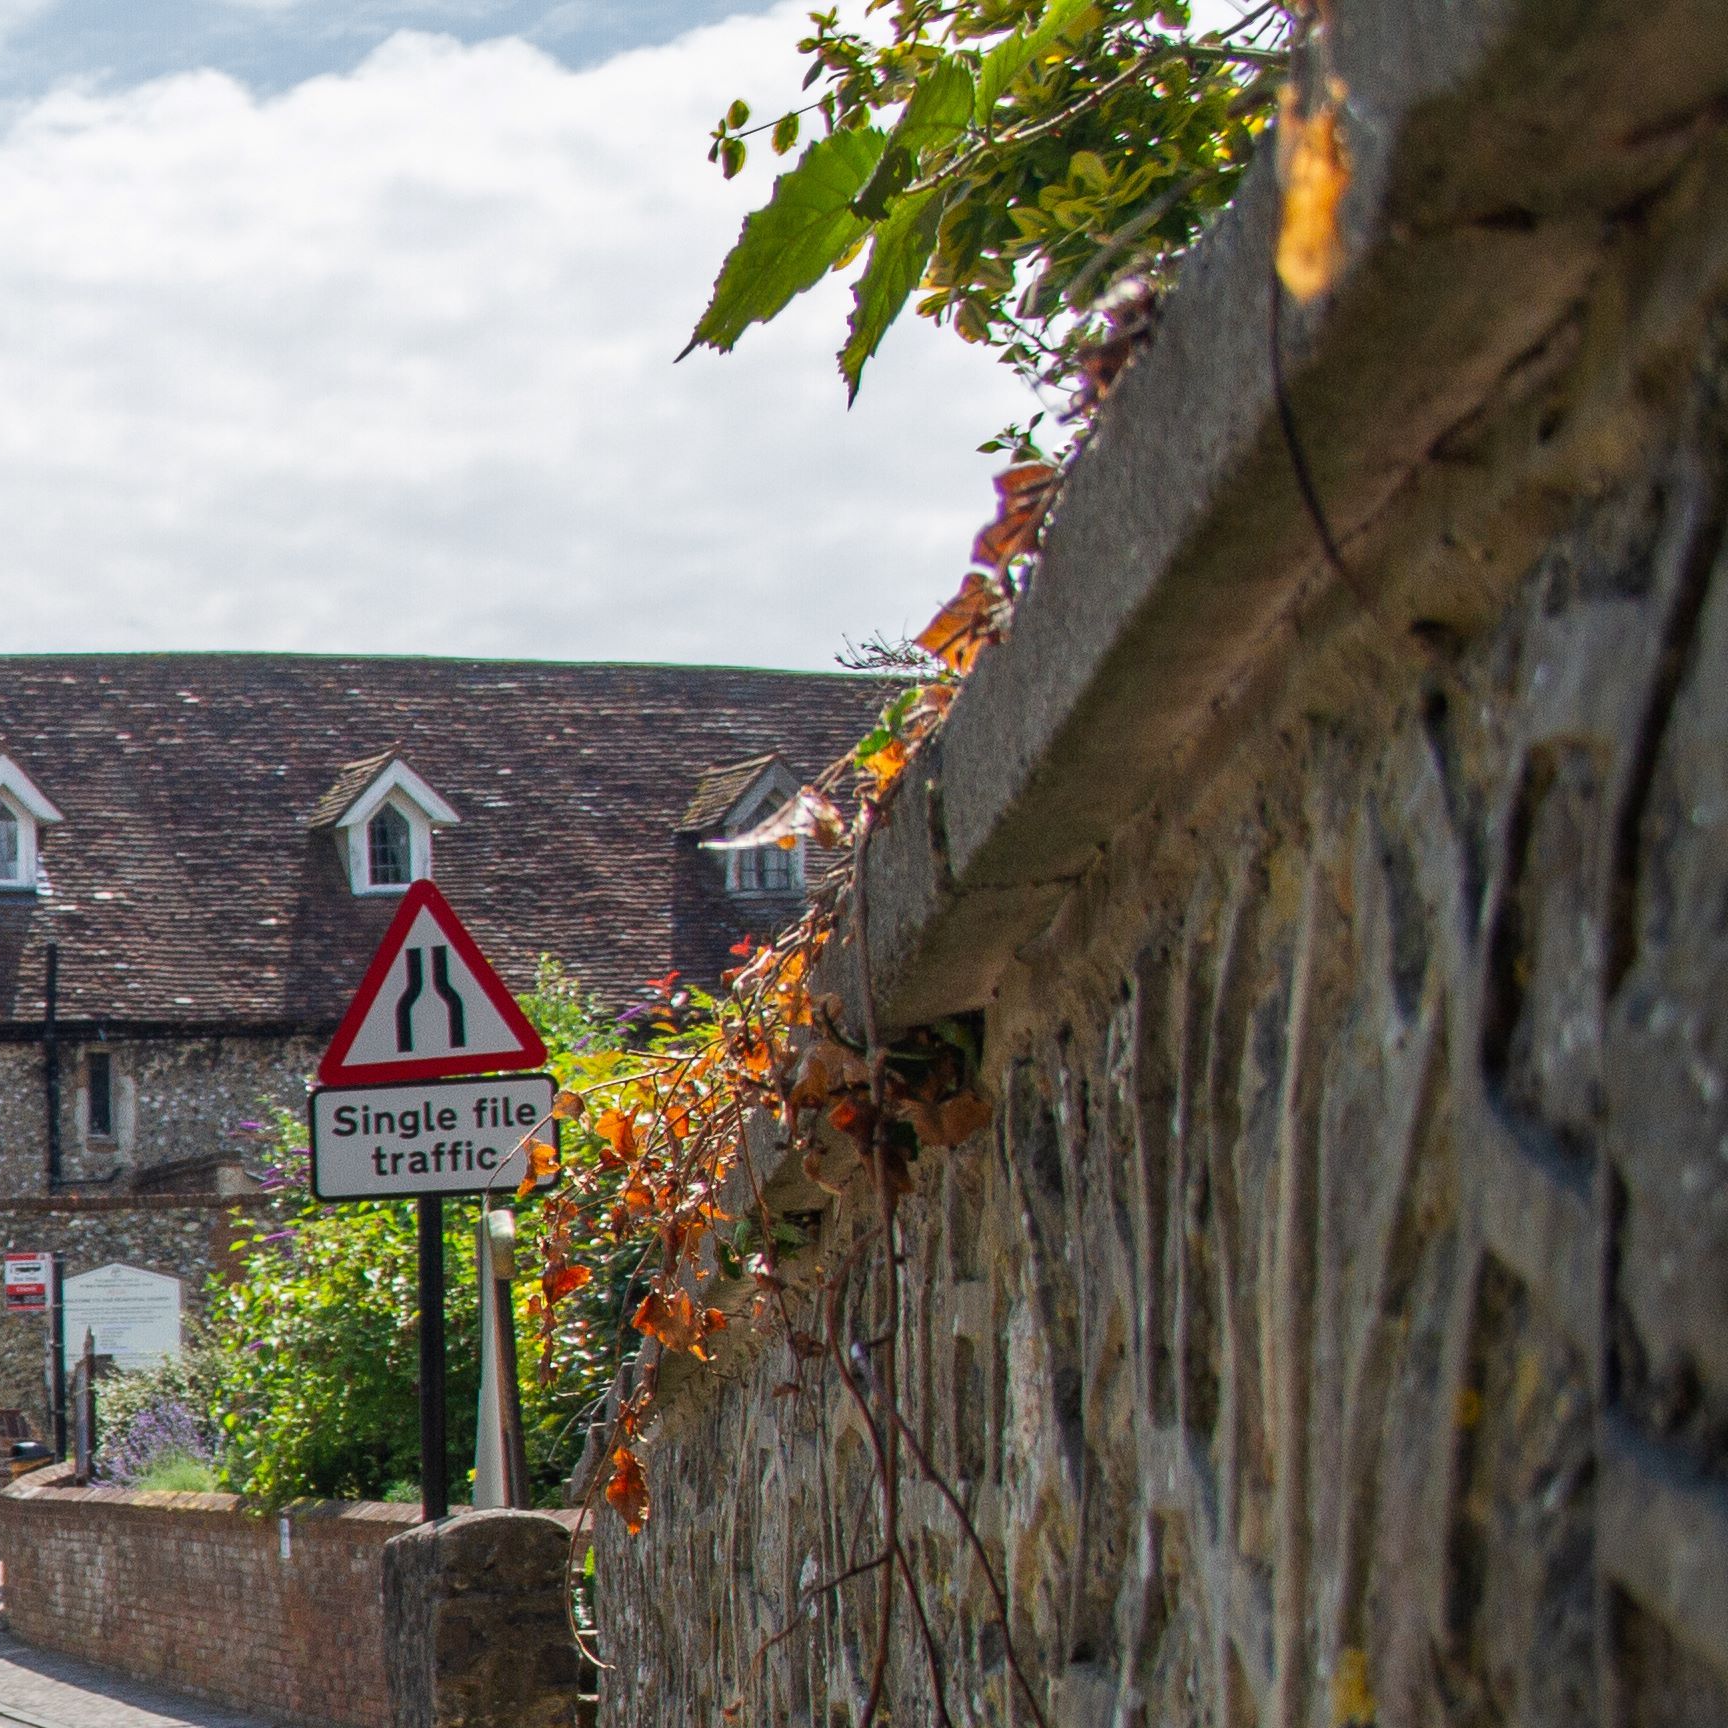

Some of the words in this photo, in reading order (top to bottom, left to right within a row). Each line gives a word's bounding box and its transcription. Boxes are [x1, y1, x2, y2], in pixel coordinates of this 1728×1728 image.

[331, 1101, 458, 1139] Single
[473, 1096, 536, 1128] file
[372, 1141, 498, 1176] traffic
